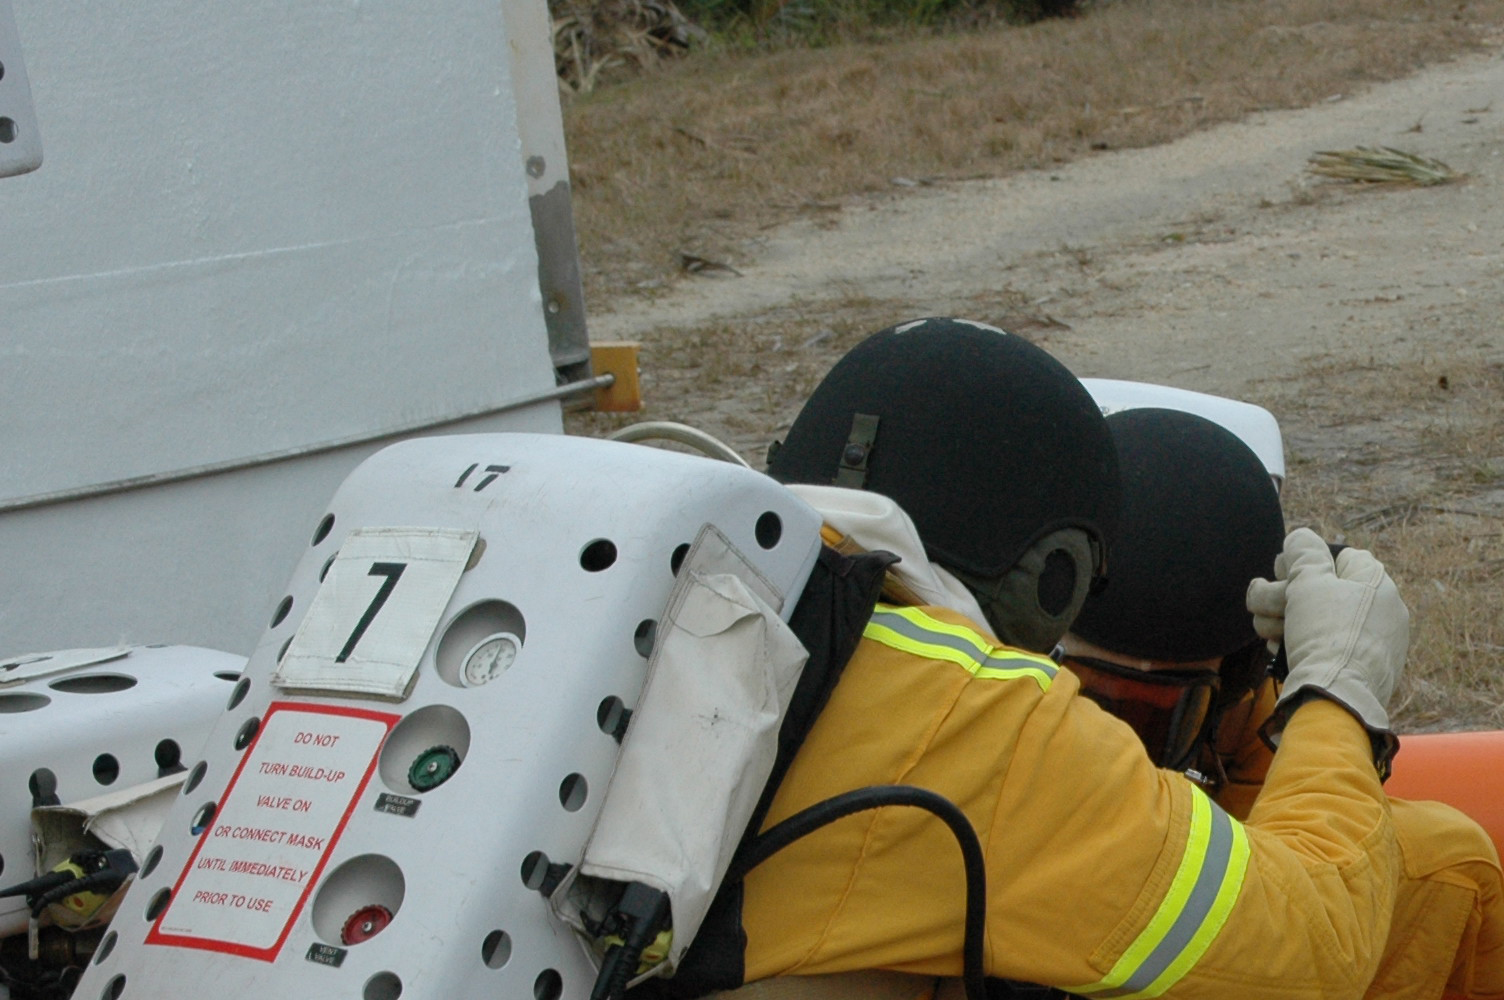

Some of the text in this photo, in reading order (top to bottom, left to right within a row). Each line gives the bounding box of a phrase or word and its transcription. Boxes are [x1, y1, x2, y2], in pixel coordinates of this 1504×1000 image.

[454, 463, 511, 492] 17
[335, 562, 408, 664] 7
[294, 732, 340, 748] DO NOT
[259, 762, 345, 783] TURN BUILD-UP
[256, 795, 312, 812] VALVE ON
[214, 825, 325, 850] OR CONNECT MASK
[197, 857, 308, 883] UNTIL IMMEDIATELY
[193, 891, 273, 913] PRIOR TO USE
